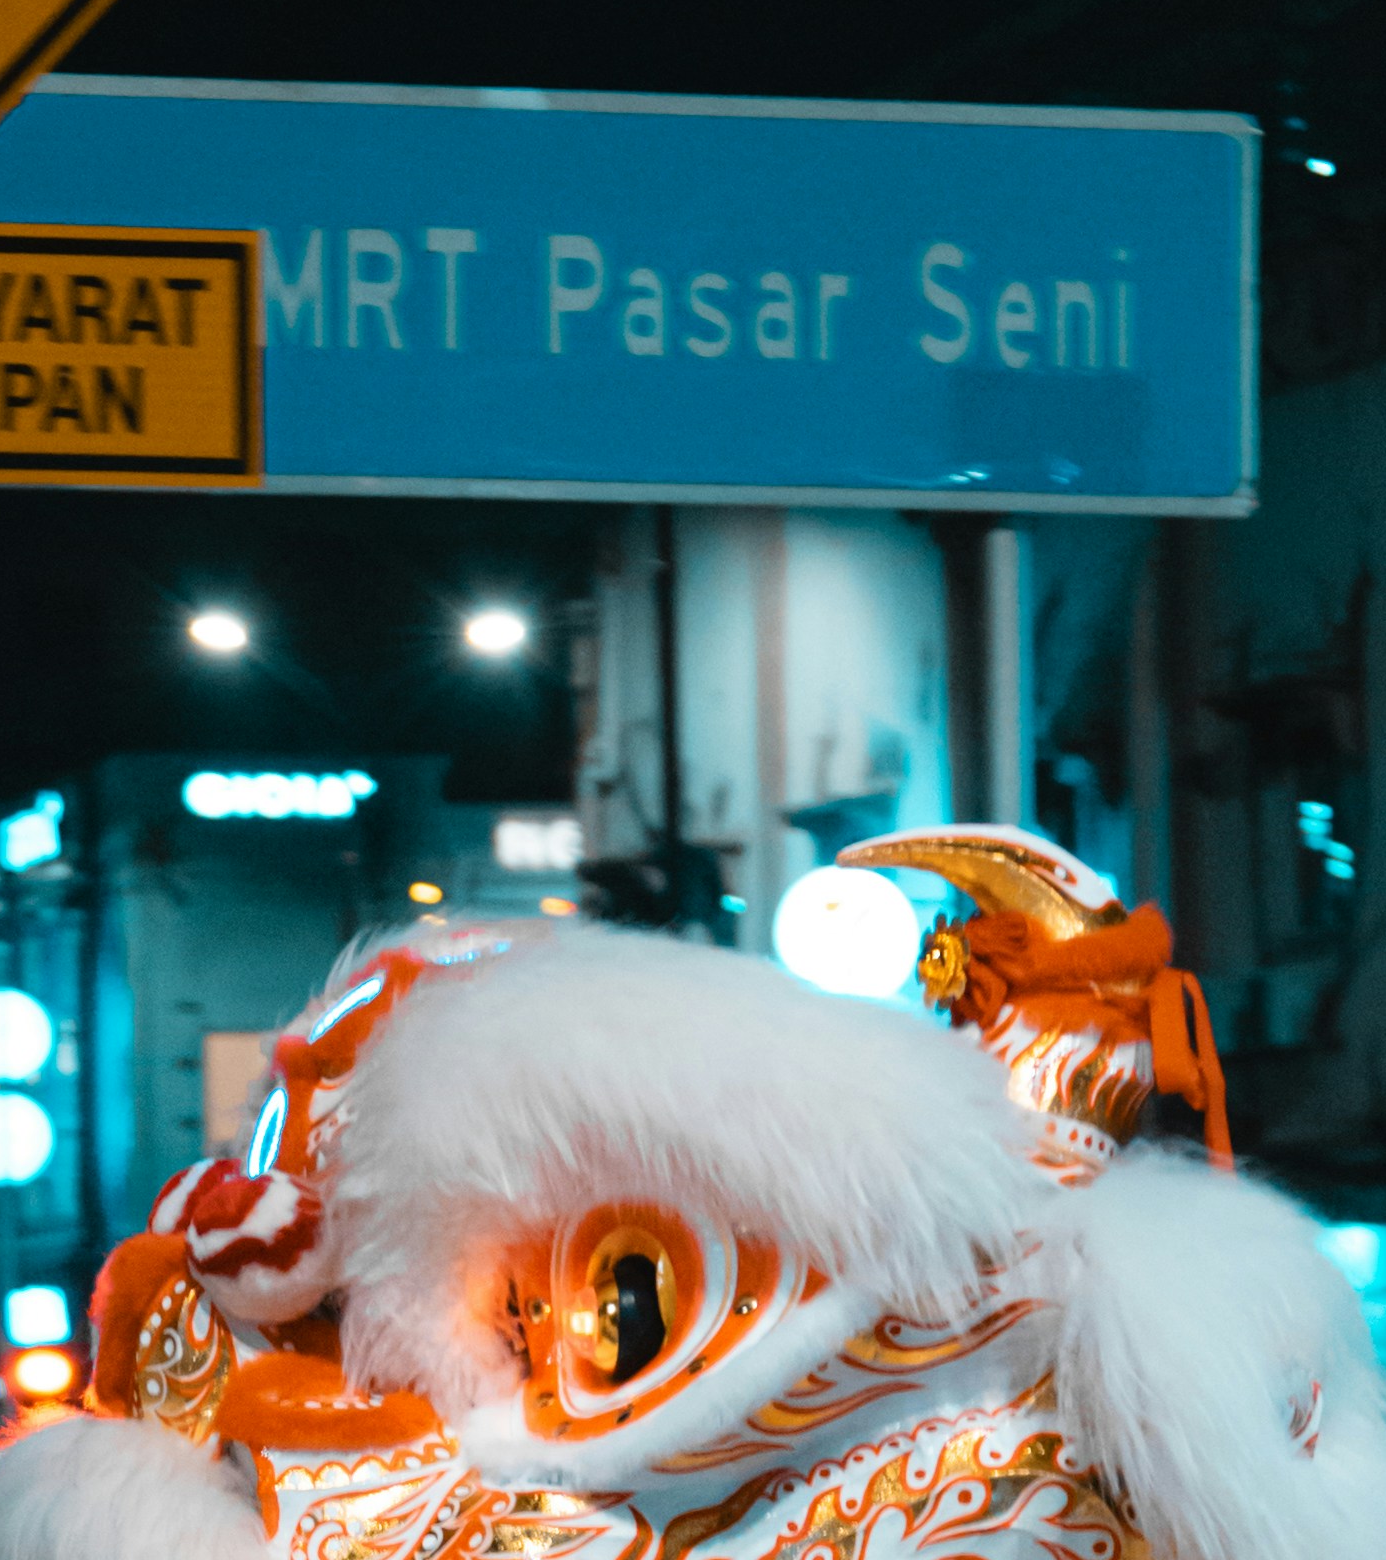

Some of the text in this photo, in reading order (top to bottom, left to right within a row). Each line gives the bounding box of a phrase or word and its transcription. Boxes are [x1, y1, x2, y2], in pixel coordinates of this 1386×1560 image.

[257, 227, 1132, 370] MRT Pasar Seni
